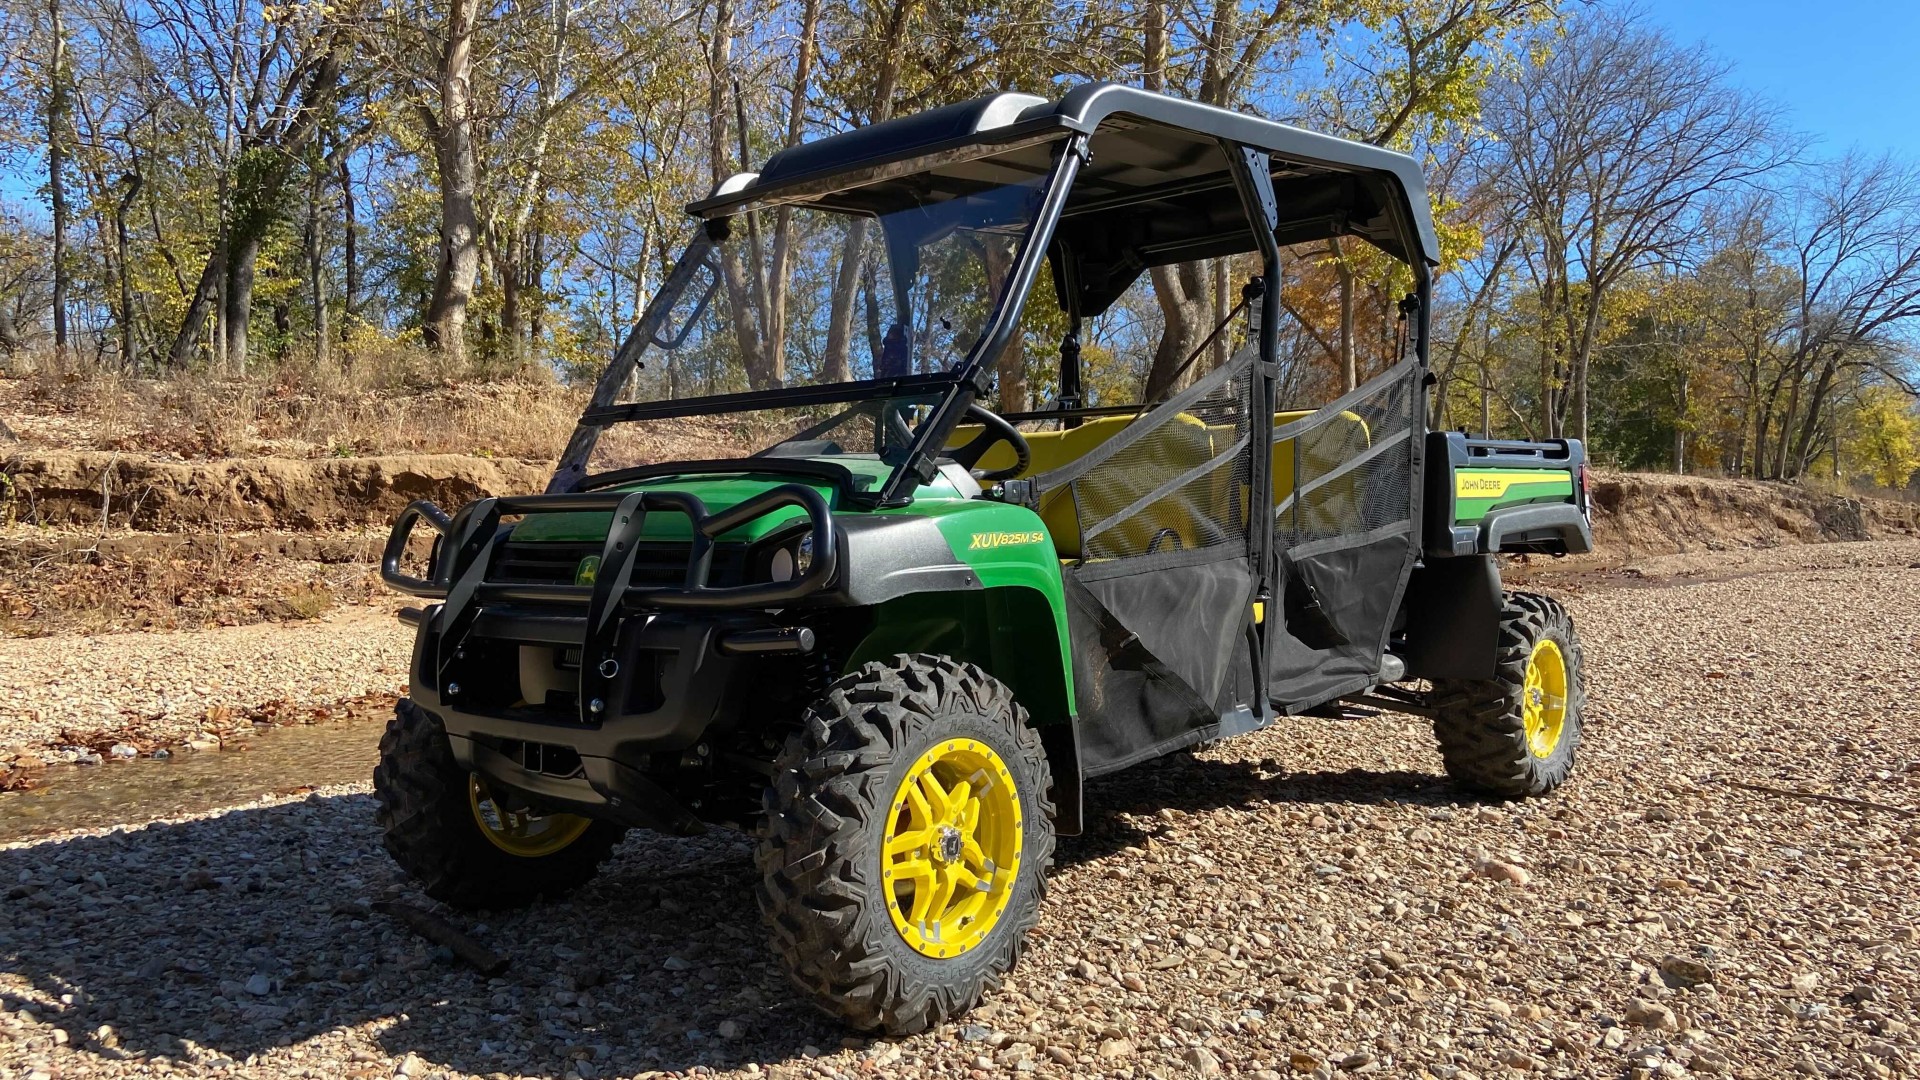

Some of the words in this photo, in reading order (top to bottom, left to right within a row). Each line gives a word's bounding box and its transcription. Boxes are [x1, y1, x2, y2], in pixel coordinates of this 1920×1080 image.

[1461, 478, 1479, 490] JOHN
[1479, 478, 1501, 490] DEERE
[1031, 532, 1044, 543] S4
